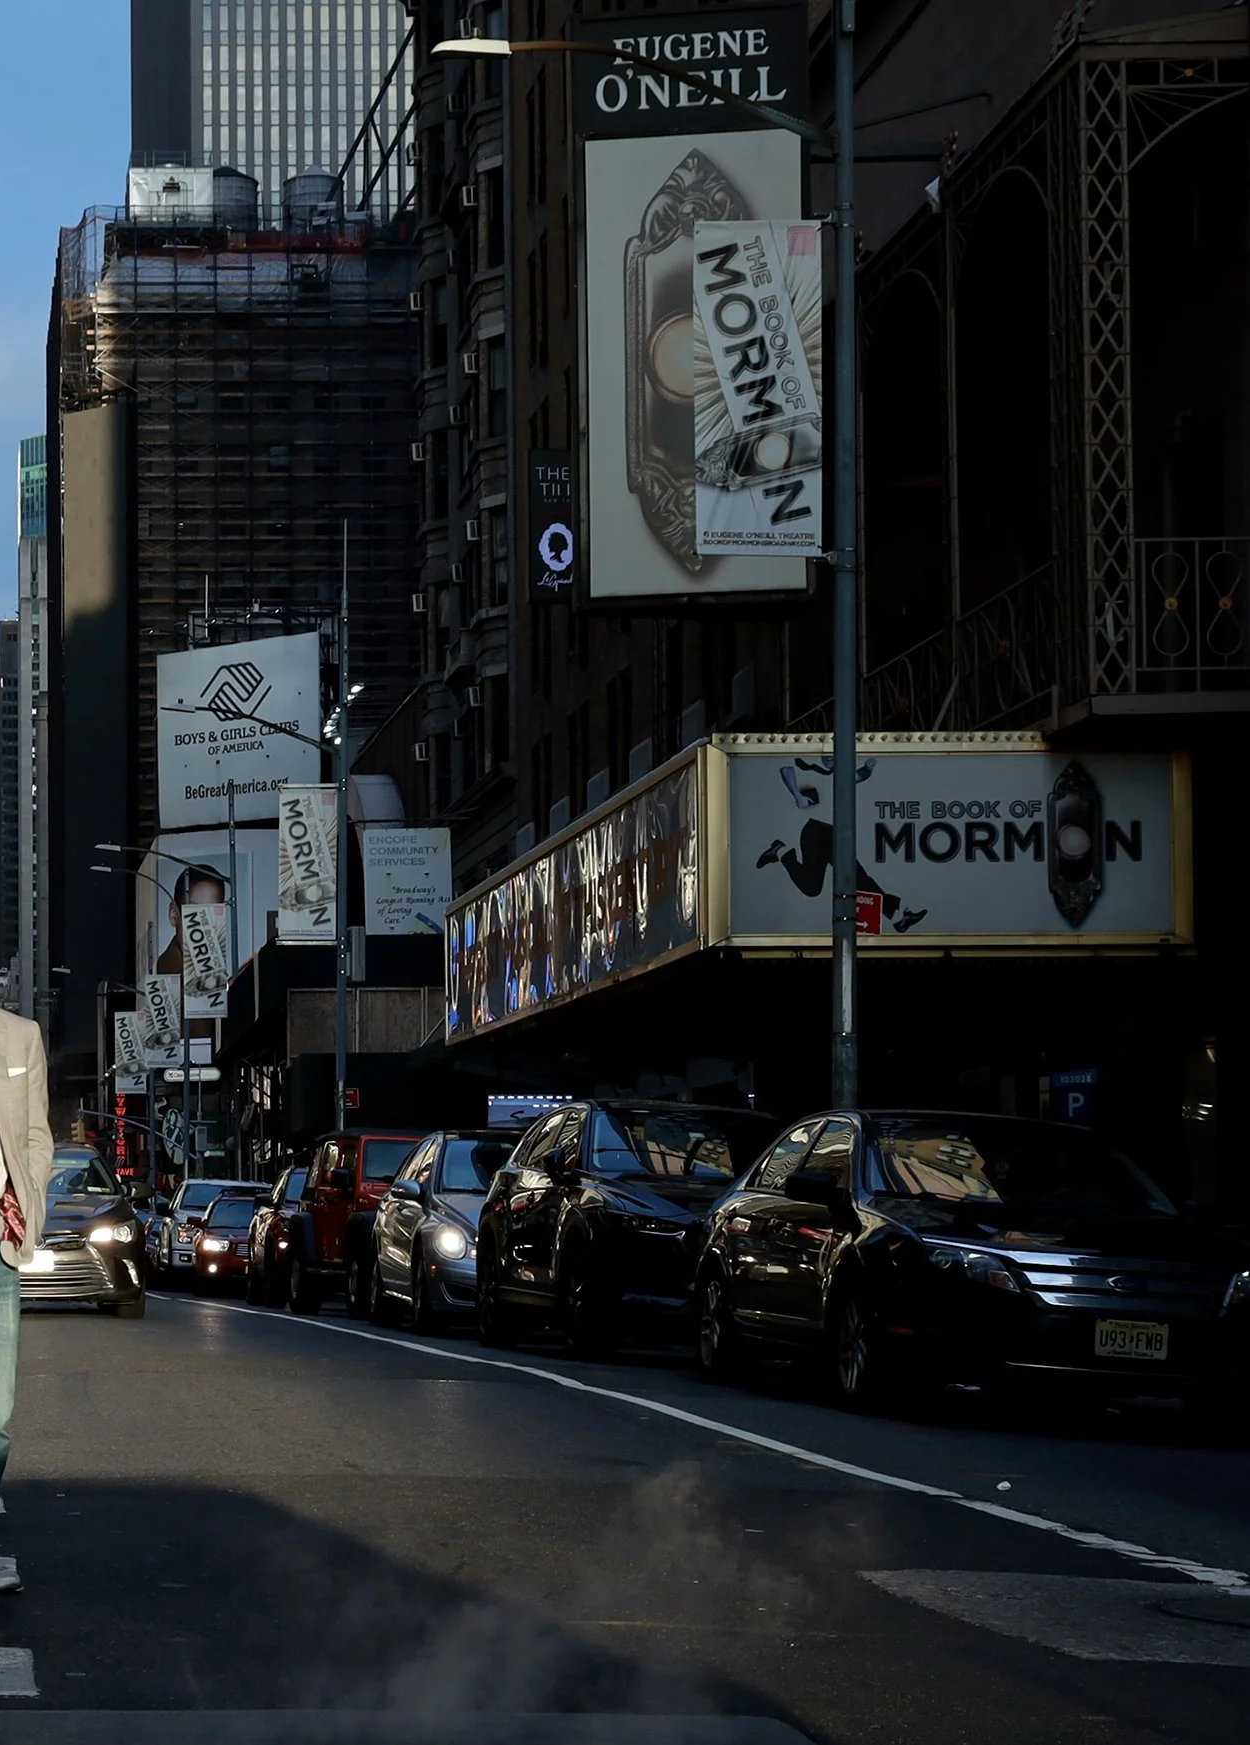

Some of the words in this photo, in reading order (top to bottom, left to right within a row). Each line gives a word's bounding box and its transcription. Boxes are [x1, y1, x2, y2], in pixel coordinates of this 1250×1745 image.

[612, 28, 769, 65] EUGENE
[595, 65, 787, 113] O'NEILL
[743, 235, 772, 288] THE
[759, 295, 795, 370] BOOK
[781, 376, 806, 410] OF
[535, 466, 570, 481] THE
[711, 531, 744, 539] EUGENE
[746, 531, 776, 539] O'NEILL
[778, 532, 815, 540] THEATRE
[174, 732, 205, 746] BOYS
[208, 731, 218, 742] &
[220, 726, 256, 741] GIRLS
[208, 745, 220, 755] OF
[222, 741, 264, 754] AMERICA
[875, 801, 921, 819] THE
[931, 801, 1001, 819] BOOK
[1009, 800, 1042, 818] OF
[368, 835, 418, 845] ENCORE
[369, 846, 438, 856] COMMUNITY
[369, 857, 426, 867] SERVICES
[406, 896, 435, 906] Running
[1067, 1092, 1085, 1118] P
